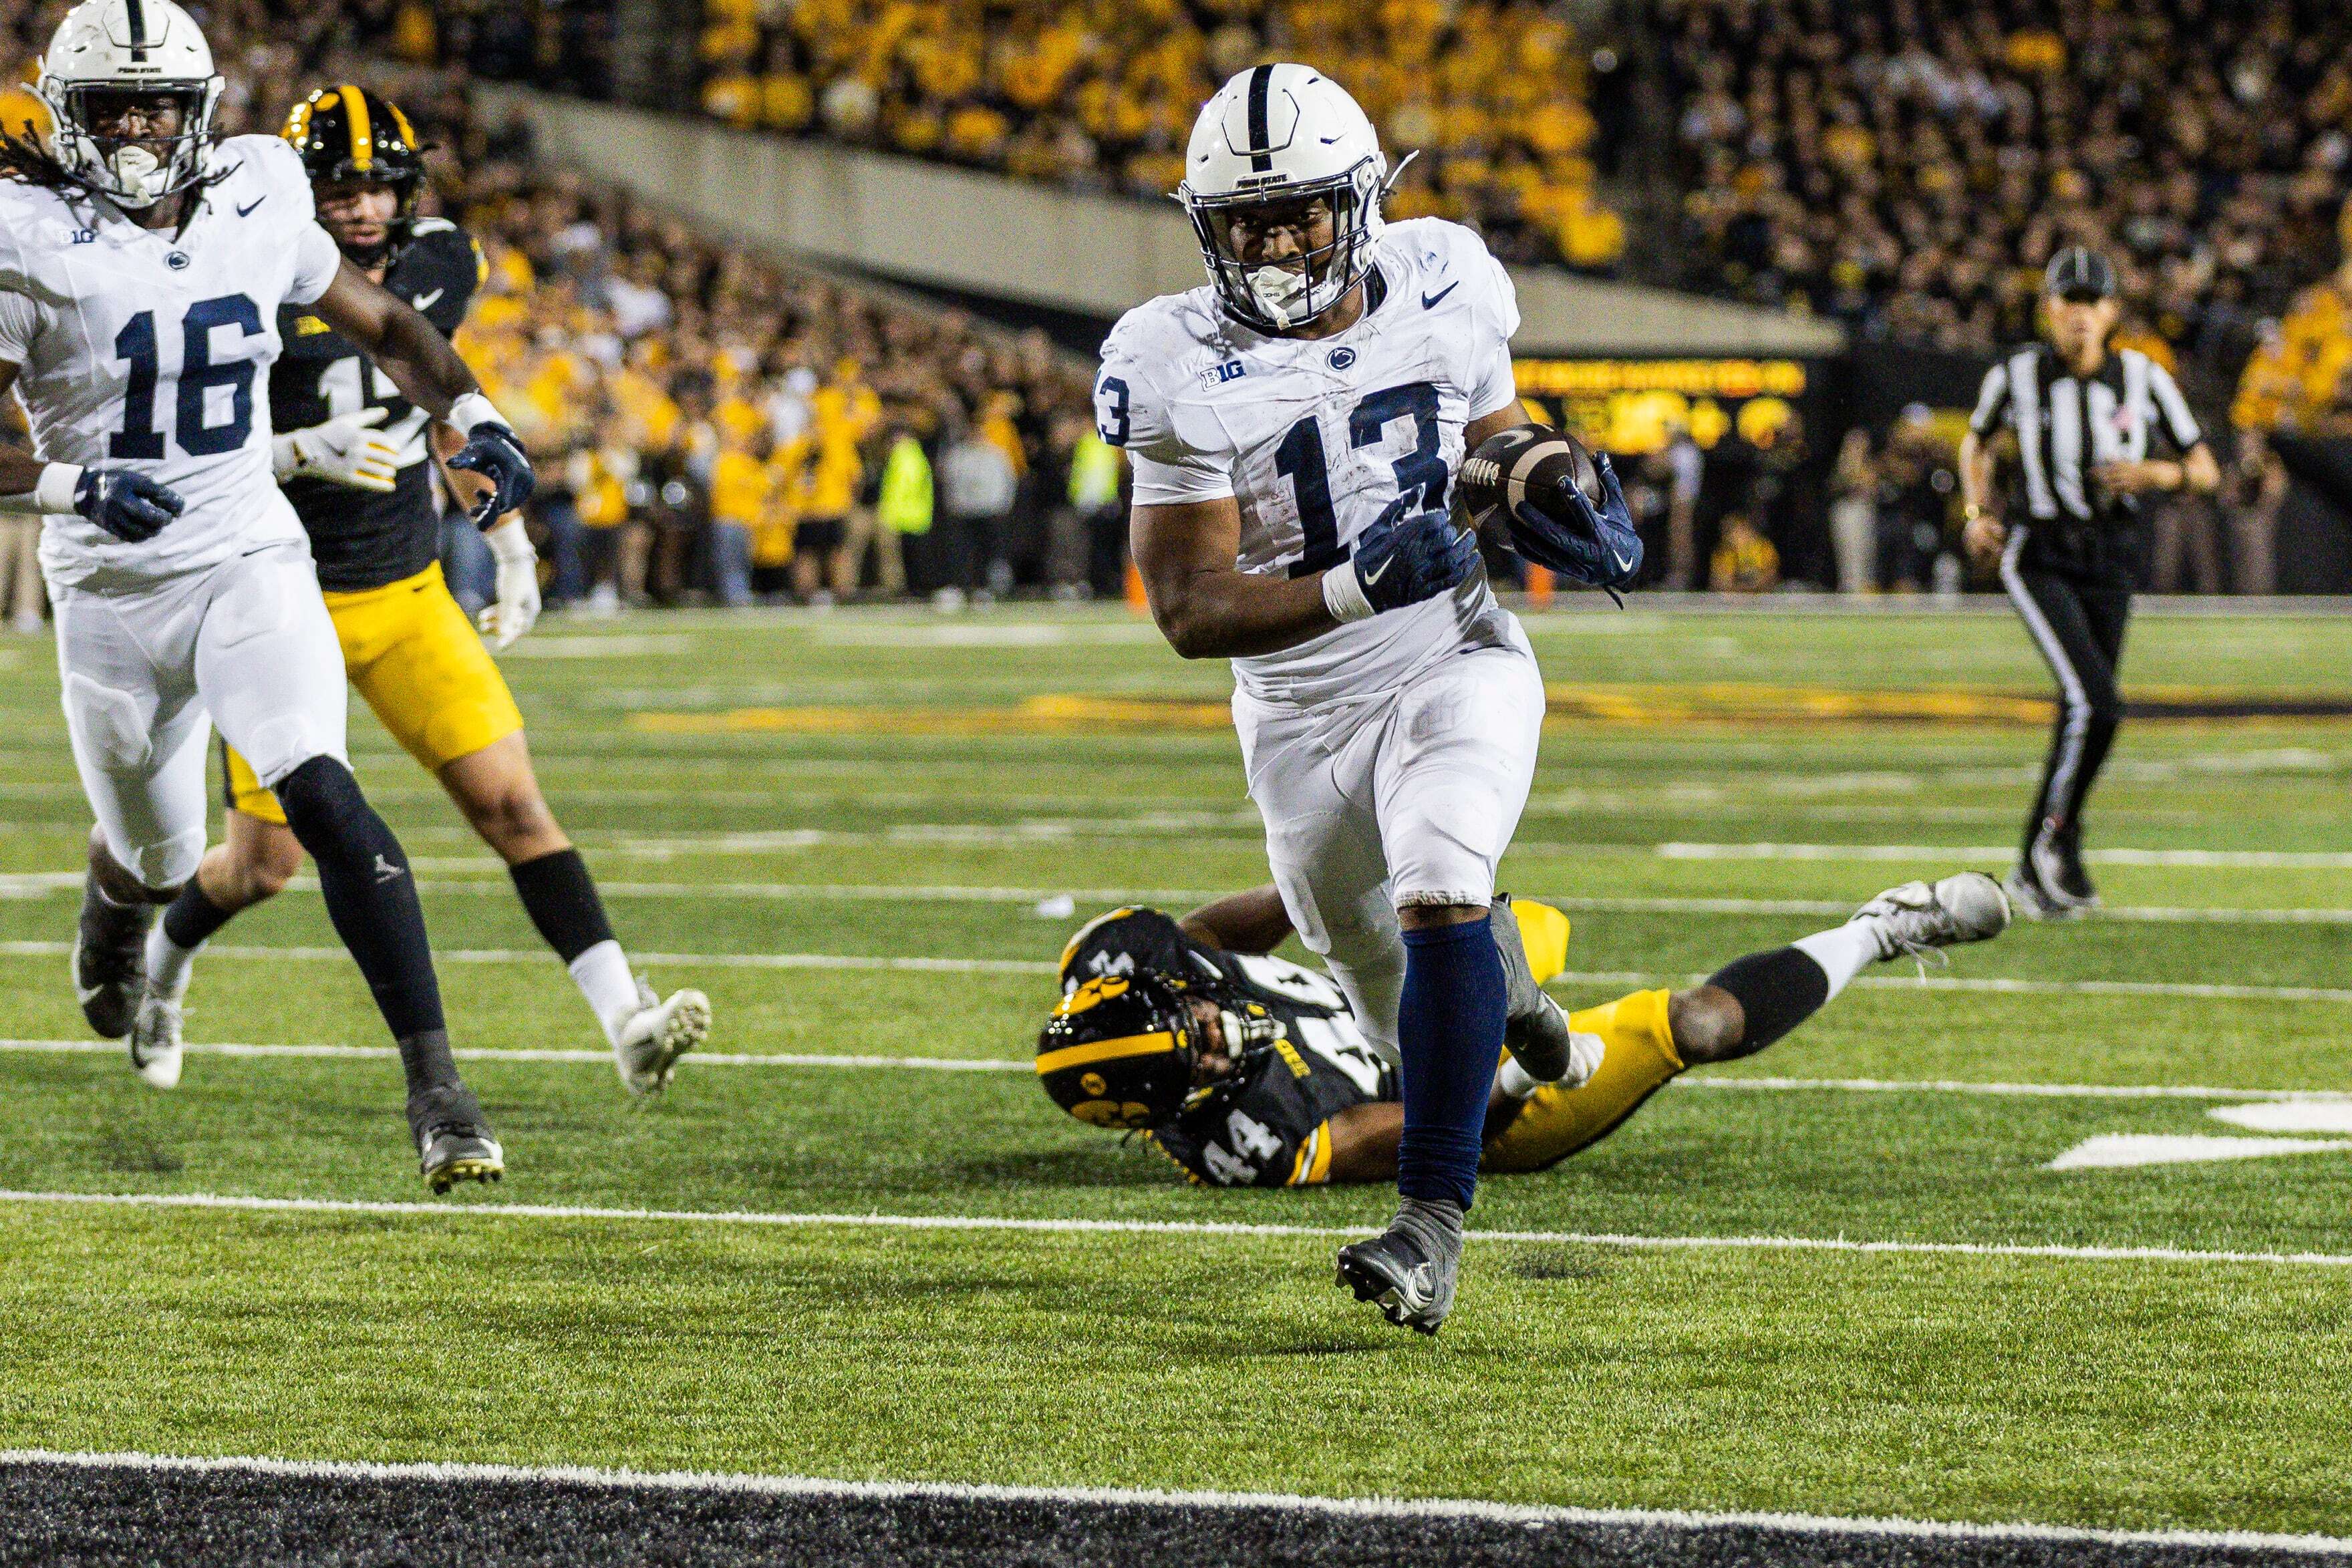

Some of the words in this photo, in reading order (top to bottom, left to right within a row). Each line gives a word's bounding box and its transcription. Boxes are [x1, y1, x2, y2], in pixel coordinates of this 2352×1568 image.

[109, 292, 265, 459] 16
[1093, 369, 1131, 446] 3
[1274, 380, 1450, 581] 13
[1203, 1108, 1283, 1187] 44
